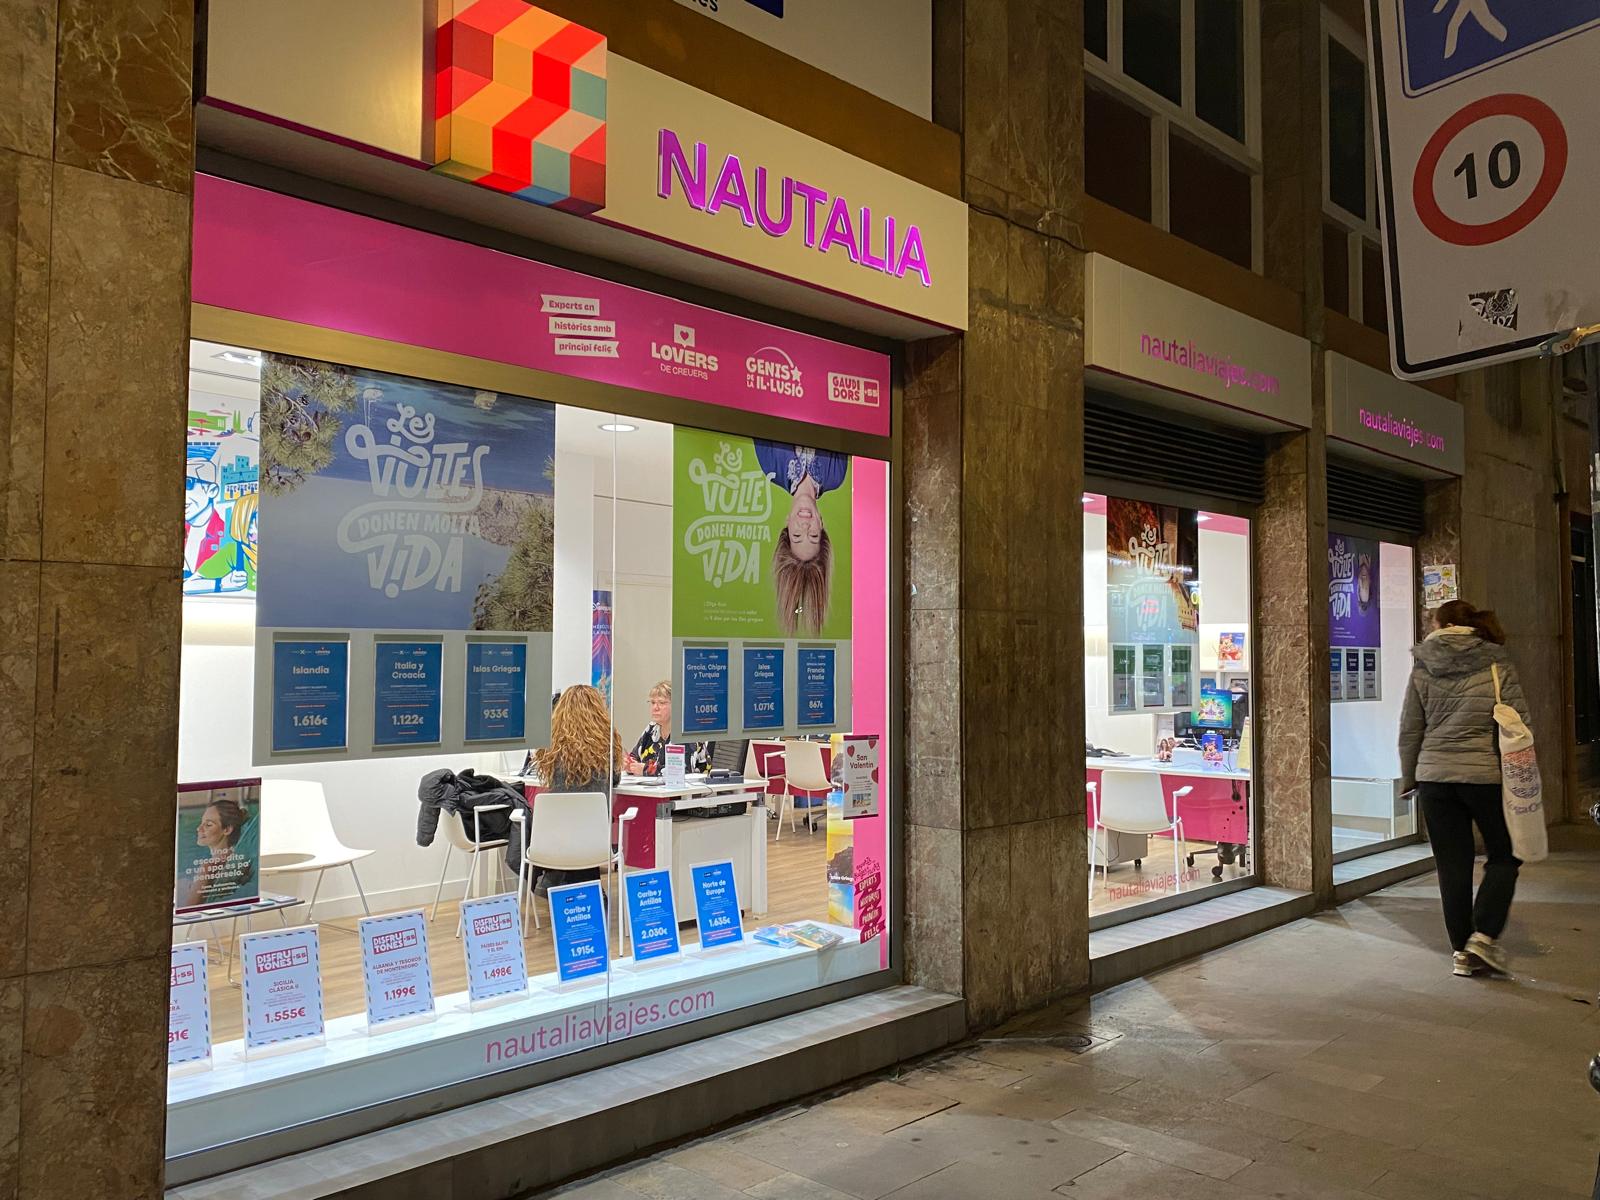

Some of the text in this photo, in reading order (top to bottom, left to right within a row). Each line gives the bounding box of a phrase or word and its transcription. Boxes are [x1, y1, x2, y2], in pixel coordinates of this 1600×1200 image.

[1454, 140, 1521, 199] 10
[657, 128, 931, 287] NAUTALIA
[593, 324, 612, 333] amb
[559, 342, 592, 352] principi
[651, 342, 719, 372] LOVERS
[660, 364, 708, 380] DE CREUERS
[746, 356, 790, 380] GENIS
[834, 388, 860, 401] DORS
[386, 402, 436, 444] Les
[714, 442, 742, 472] Les
[358, 511, 481, 538] DONEN MOLTA
[696, 524, 771, 542] DONEN MOLTA
[293, 665, 330, 675] Islandia
[395, 661, 424, 671] Italia y
[473, 665, 520, 674] Islas Griegas
[483, 708, 509, 719] 933€
[695, 705, 718, 714] 1.081€
[754, 703, 775, 712] 1.071€
[293, 715, 328, 726] 1.616€
[392, 715, 424, 726] 1.122€
[208, 864, 224, 872] spa
[702, 881, 720, 889] Norte
[1108, 867, 1200, 902] nautaliaviajes.com
[640, 897, 662, 907] Antillas
[587, 904, 591, 914] y
[566, 913, 591, 923] Antillas
[374, 940, 404, 953] TONES
[571, 945, 594, 958] 1.915€
[257, 949, 291, 964] DISFRU
[258, 958, 292, 972] TONES
[483, 966, 512, 980] 1.498€
[384, 986, 416, 1001] 1.199€
[265, 1006, 306, 1023] 1.555€
[486, 990, 714, 1064] nautaliaviajes.com
